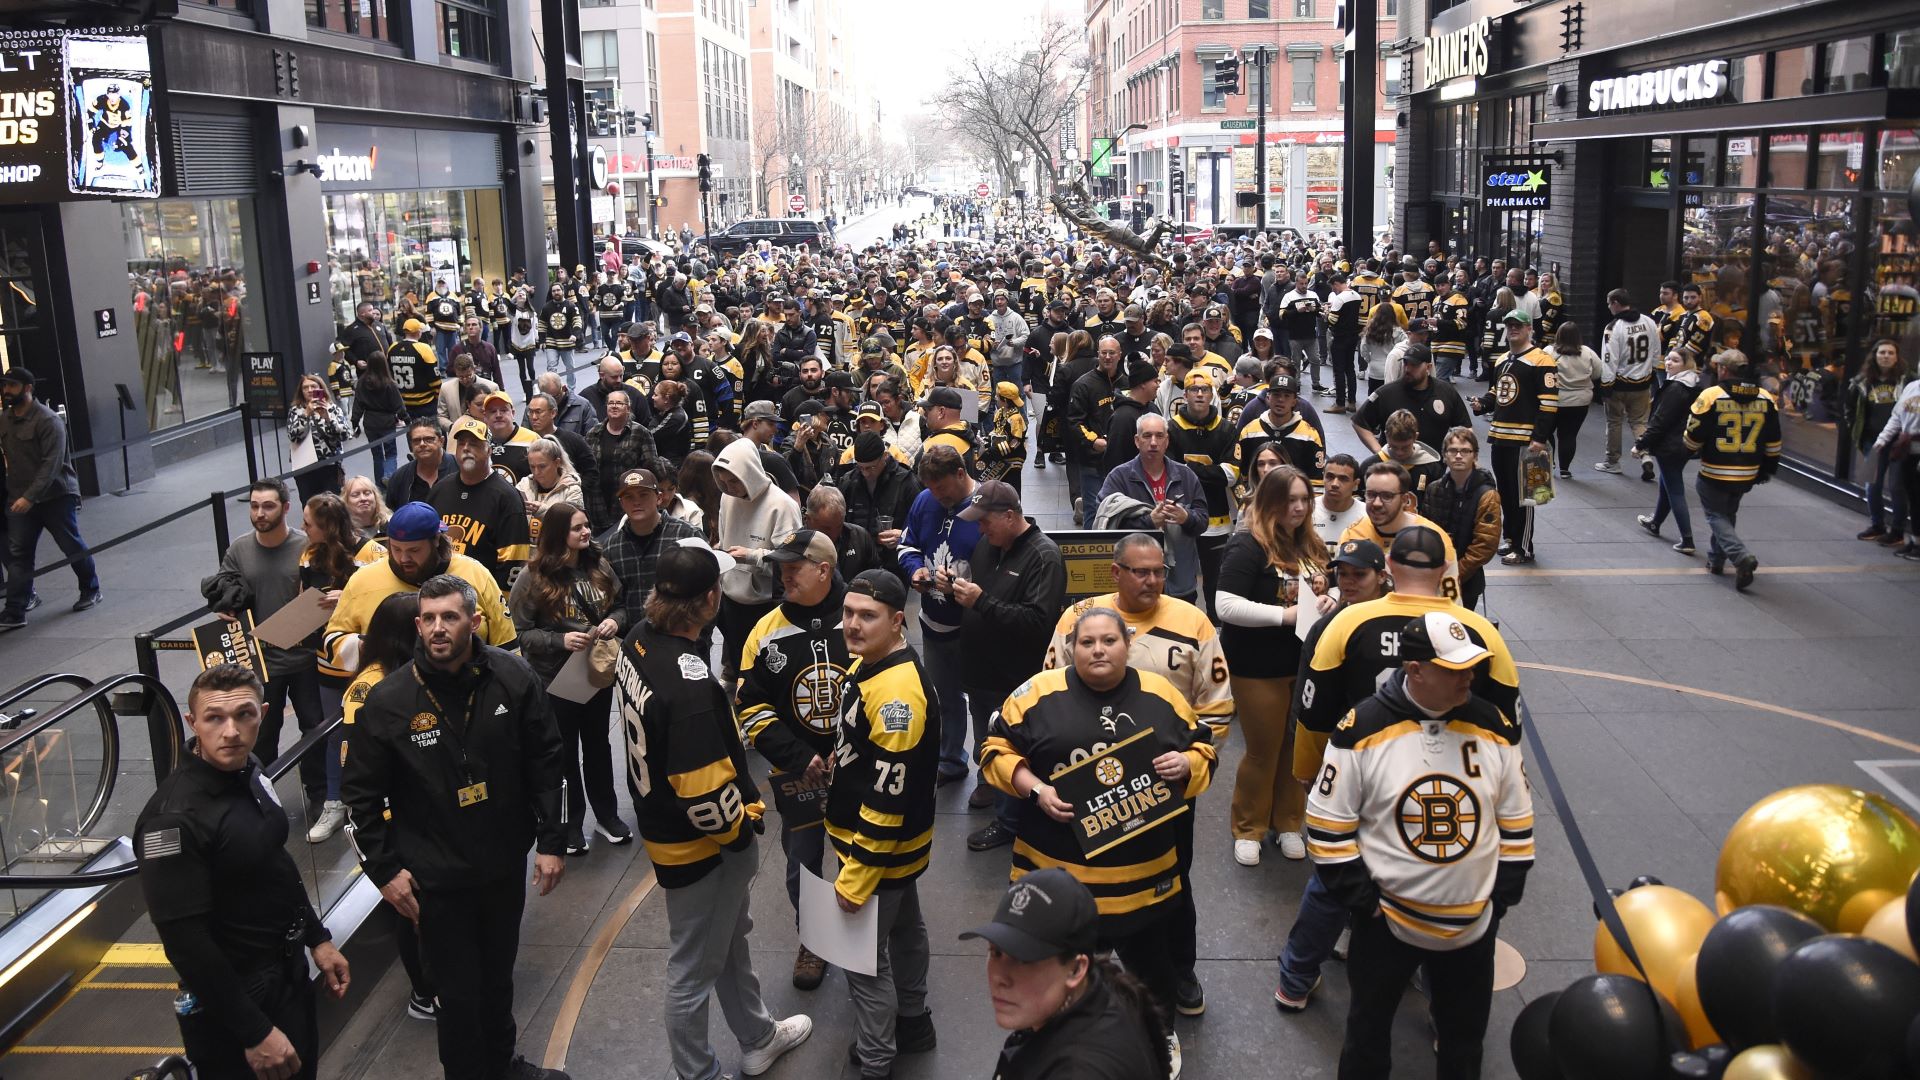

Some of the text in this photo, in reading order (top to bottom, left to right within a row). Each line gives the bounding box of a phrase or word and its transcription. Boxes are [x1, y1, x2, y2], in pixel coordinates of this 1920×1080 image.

[1424, 15, 1488, 89] BANNERS
[1588, 60, 1727, 112] STARBUCKS
[1222, 119, 1249, 129] CAUSEWAY
[1486, 171, 1529, 186] star
[1486, 197, 1546, 207] PHARMACY
[820, 325, 833, 336] 73
[1626, 323, 1647, 335] ZACHA
[1626, 334, 1649, 365] 18
[251, 357, 273, 370] PLAY
[693, 369, 702, 380] C
[393, 366, 415, 389] 63
[1715, 412, 1765, 453] 37
[1062, 545, 1086, 554] BAG
[1167, 645, 1183, 671] C
[1210, 656, 1227, 684] 6
[411, 729, 441, 742] EVENTS
[417, 738, 438, 748] TEAM
[1460, 740, 1482, 779] C
[873, 759, 907, 796] 73
[1087, 773, 1152, 813] LET'S GO
[686, 782, 743, 832] 88
[1080, 781, 1172, 838] BRUINS
